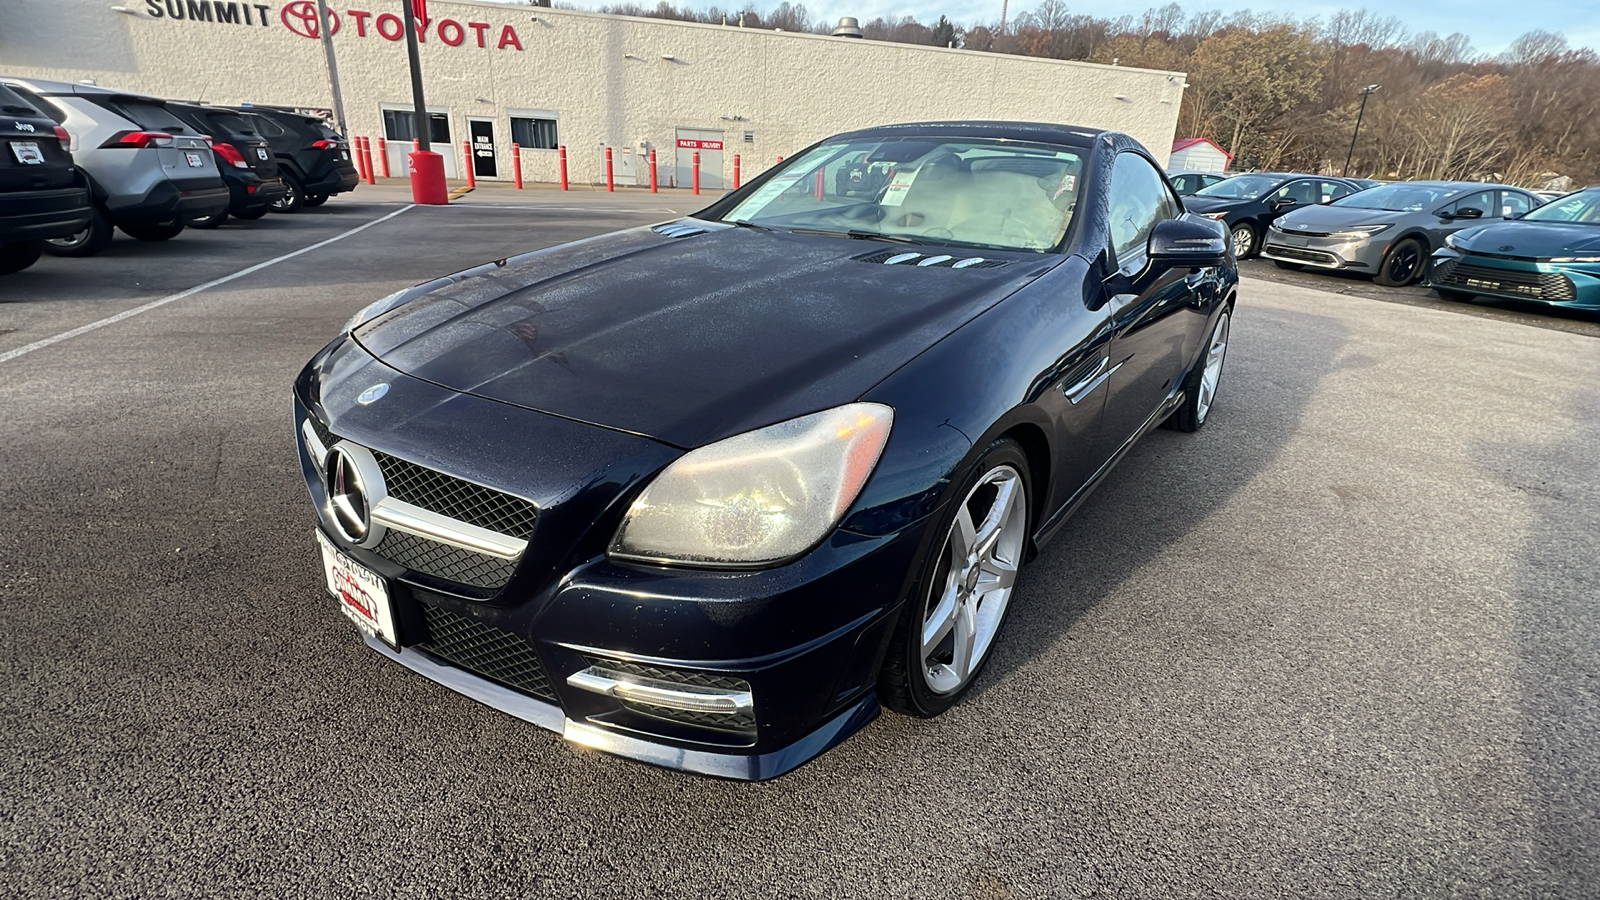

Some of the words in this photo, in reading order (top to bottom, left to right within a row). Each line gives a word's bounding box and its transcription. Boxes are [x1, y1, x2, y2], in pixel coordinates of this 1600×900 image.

[145, 0, 270, 27] SUMMIT
[347, 9, 523, 51] TOYOTA
[680, 140, 697, 148] PARTS
